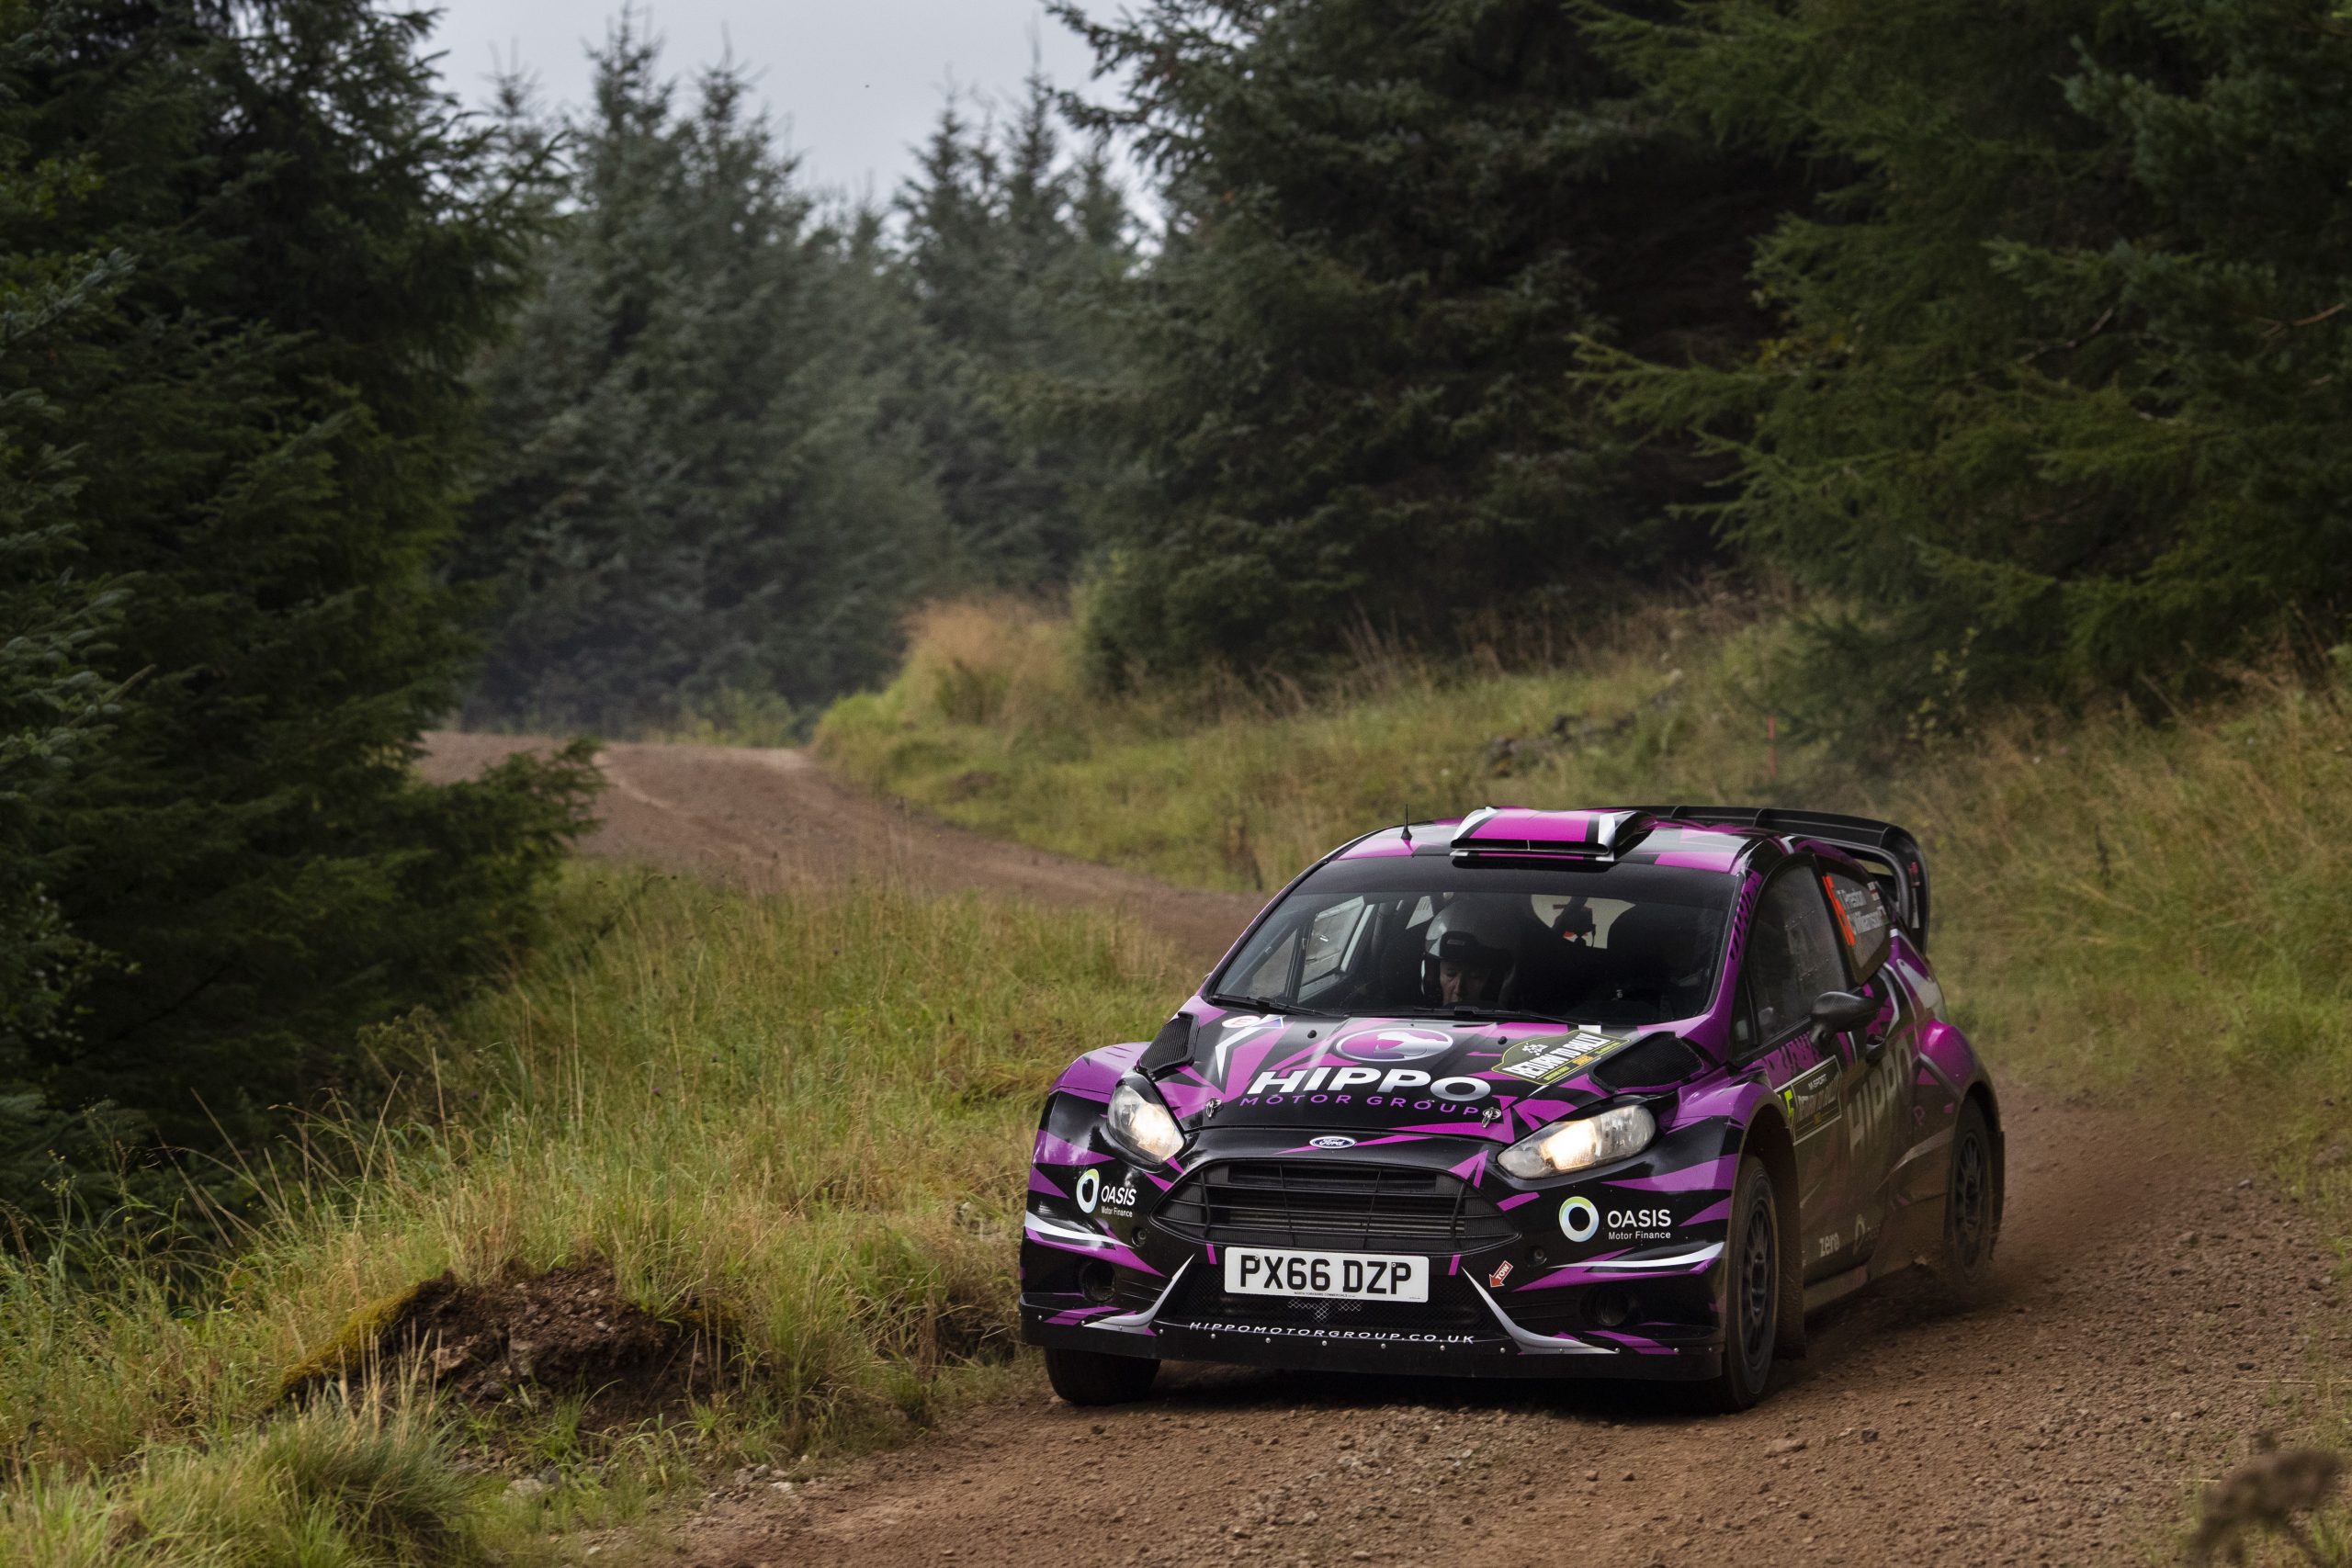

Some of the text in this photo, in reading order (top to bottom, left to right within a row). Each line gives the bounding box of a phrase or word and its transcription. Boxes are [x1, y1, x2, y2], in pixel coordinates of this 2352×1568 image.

[1562, 1032, 1611, 1052] RALLY
[1549, 1047, 1582, 1059] TO
[1501, 1054, 1569, 1078] RETURN
[1248, 1067, 1491, 1100] HIPPO
[1240, 1094, 1478, 1115] MOTOR GROUP
[1101, 1185, 1137, 1206] OASIS
[1101, 1205, 1133, 1218] Motor Finance
[1607, 1209, 1671, 1228] OASIS
[1608, 1231, 1671, 1240] Motor Finance
[1240, 1255, 1411, 1295] PX66 DZP
[1496, 1264, 1510, 1280] TOW
[1189, 1322, 1475, 1344] HIPPOMOTORGROUP.CO.UK
